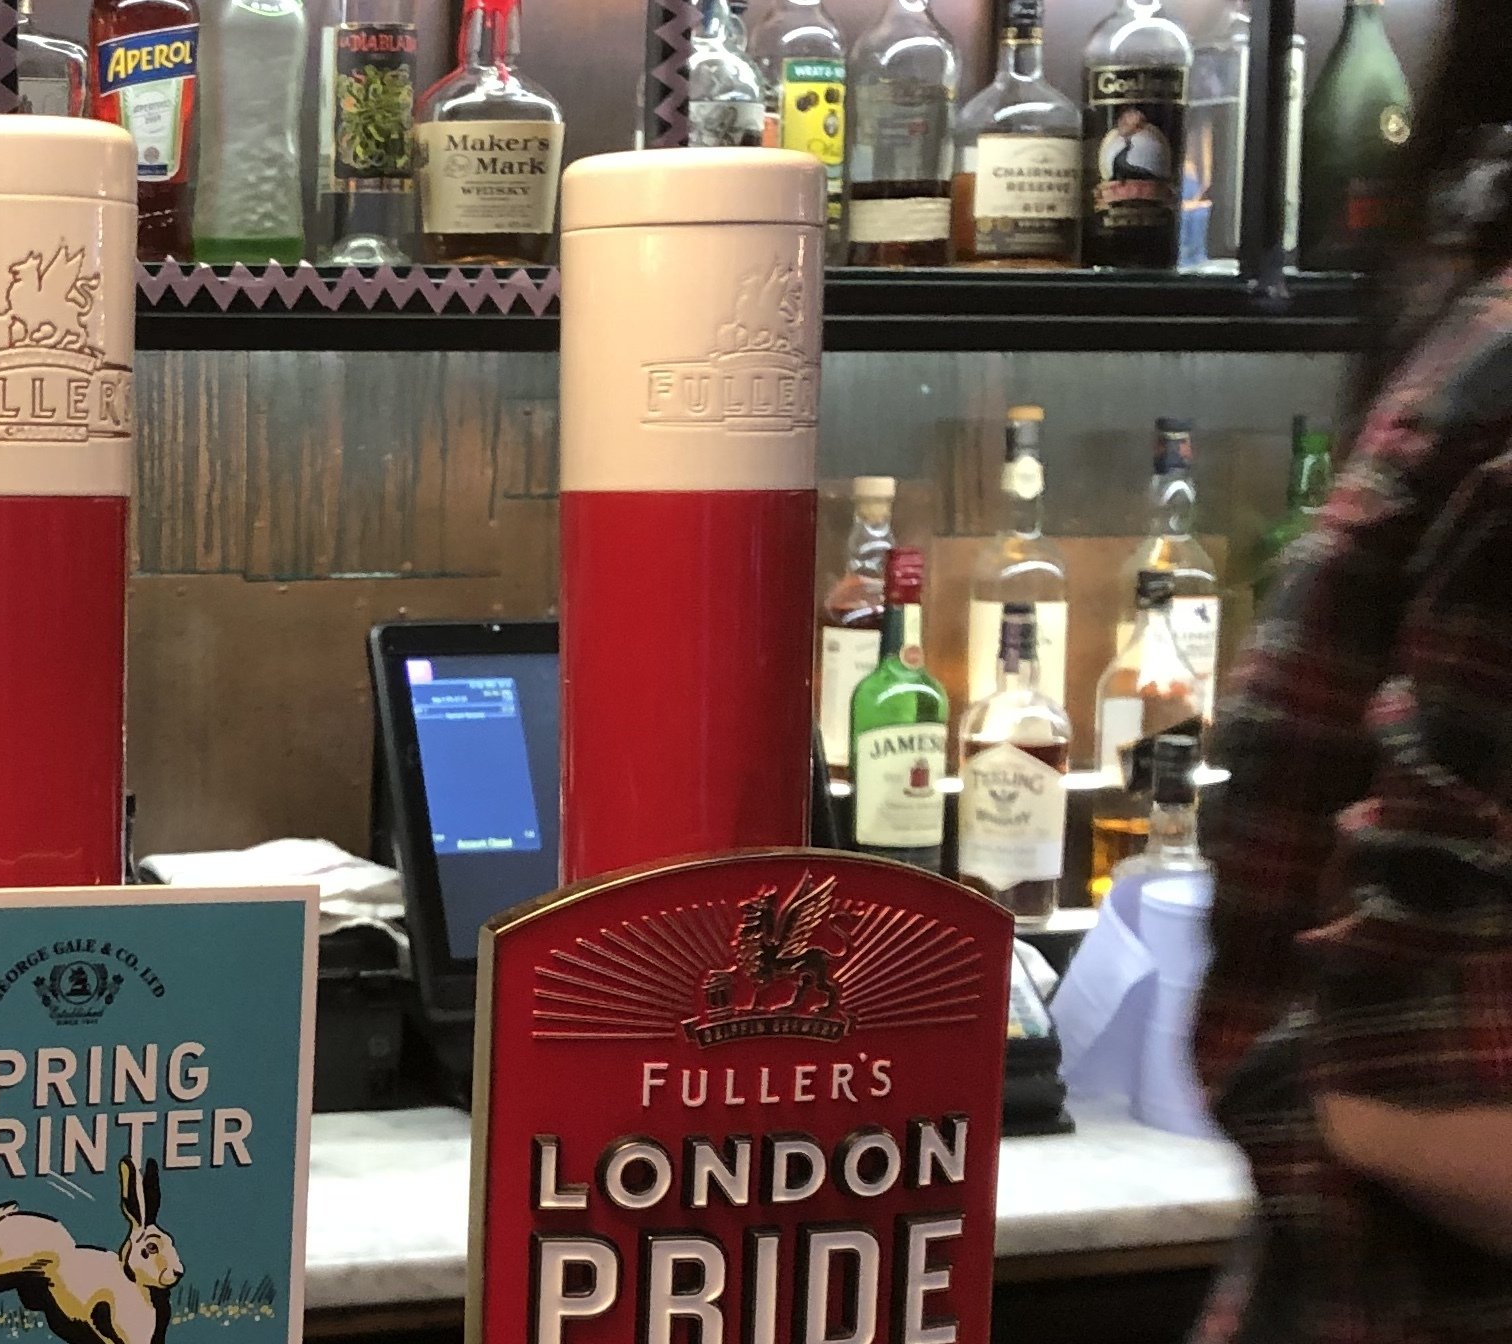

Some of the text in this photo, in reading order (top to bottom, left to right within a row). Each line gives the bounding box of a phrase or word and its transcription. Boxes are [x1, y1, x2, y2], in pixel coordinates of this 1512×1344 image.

[107, 40, 194, 83] APEROL
[444, 134, 551, 153] Maker's
[476, 157, 547, 175] Mark
[460, 186, 532, 196] WHISKY
[1005, 182, 1071, 194] RESERVE
[1022, 203, 1058, 214] RUM
[53, 938, 98, 955] GALE
[99, 941, 114, 955] &
[115, 947, 141, 974] CO.
[138, 967, 167, 1000] LTD
[640, 1052, 893, 1108] FULLER'S
[531, 1114, 969, 1211] LONDON
